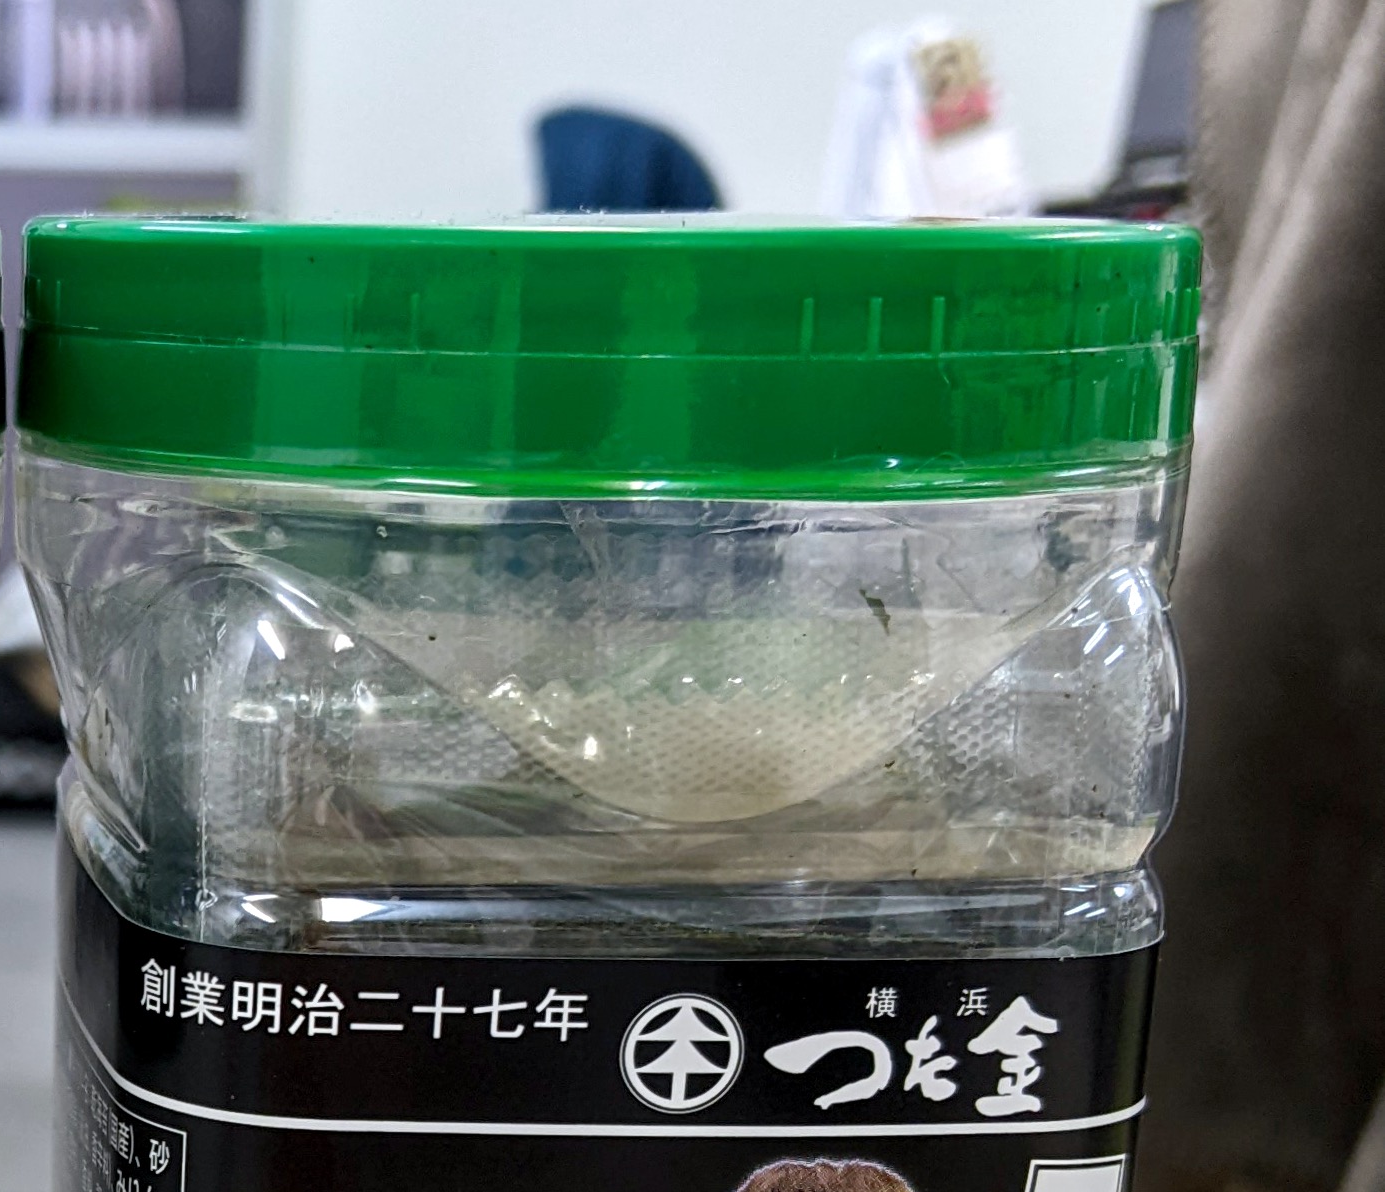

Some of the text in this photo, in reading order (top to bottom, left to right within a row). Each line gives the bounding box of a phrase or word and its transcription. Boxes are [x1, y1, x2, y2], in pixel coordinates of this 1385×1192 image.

[140, 958, 589, 1042] 創業明治二十七年
[865, 986, 989, 1019] 横浜
